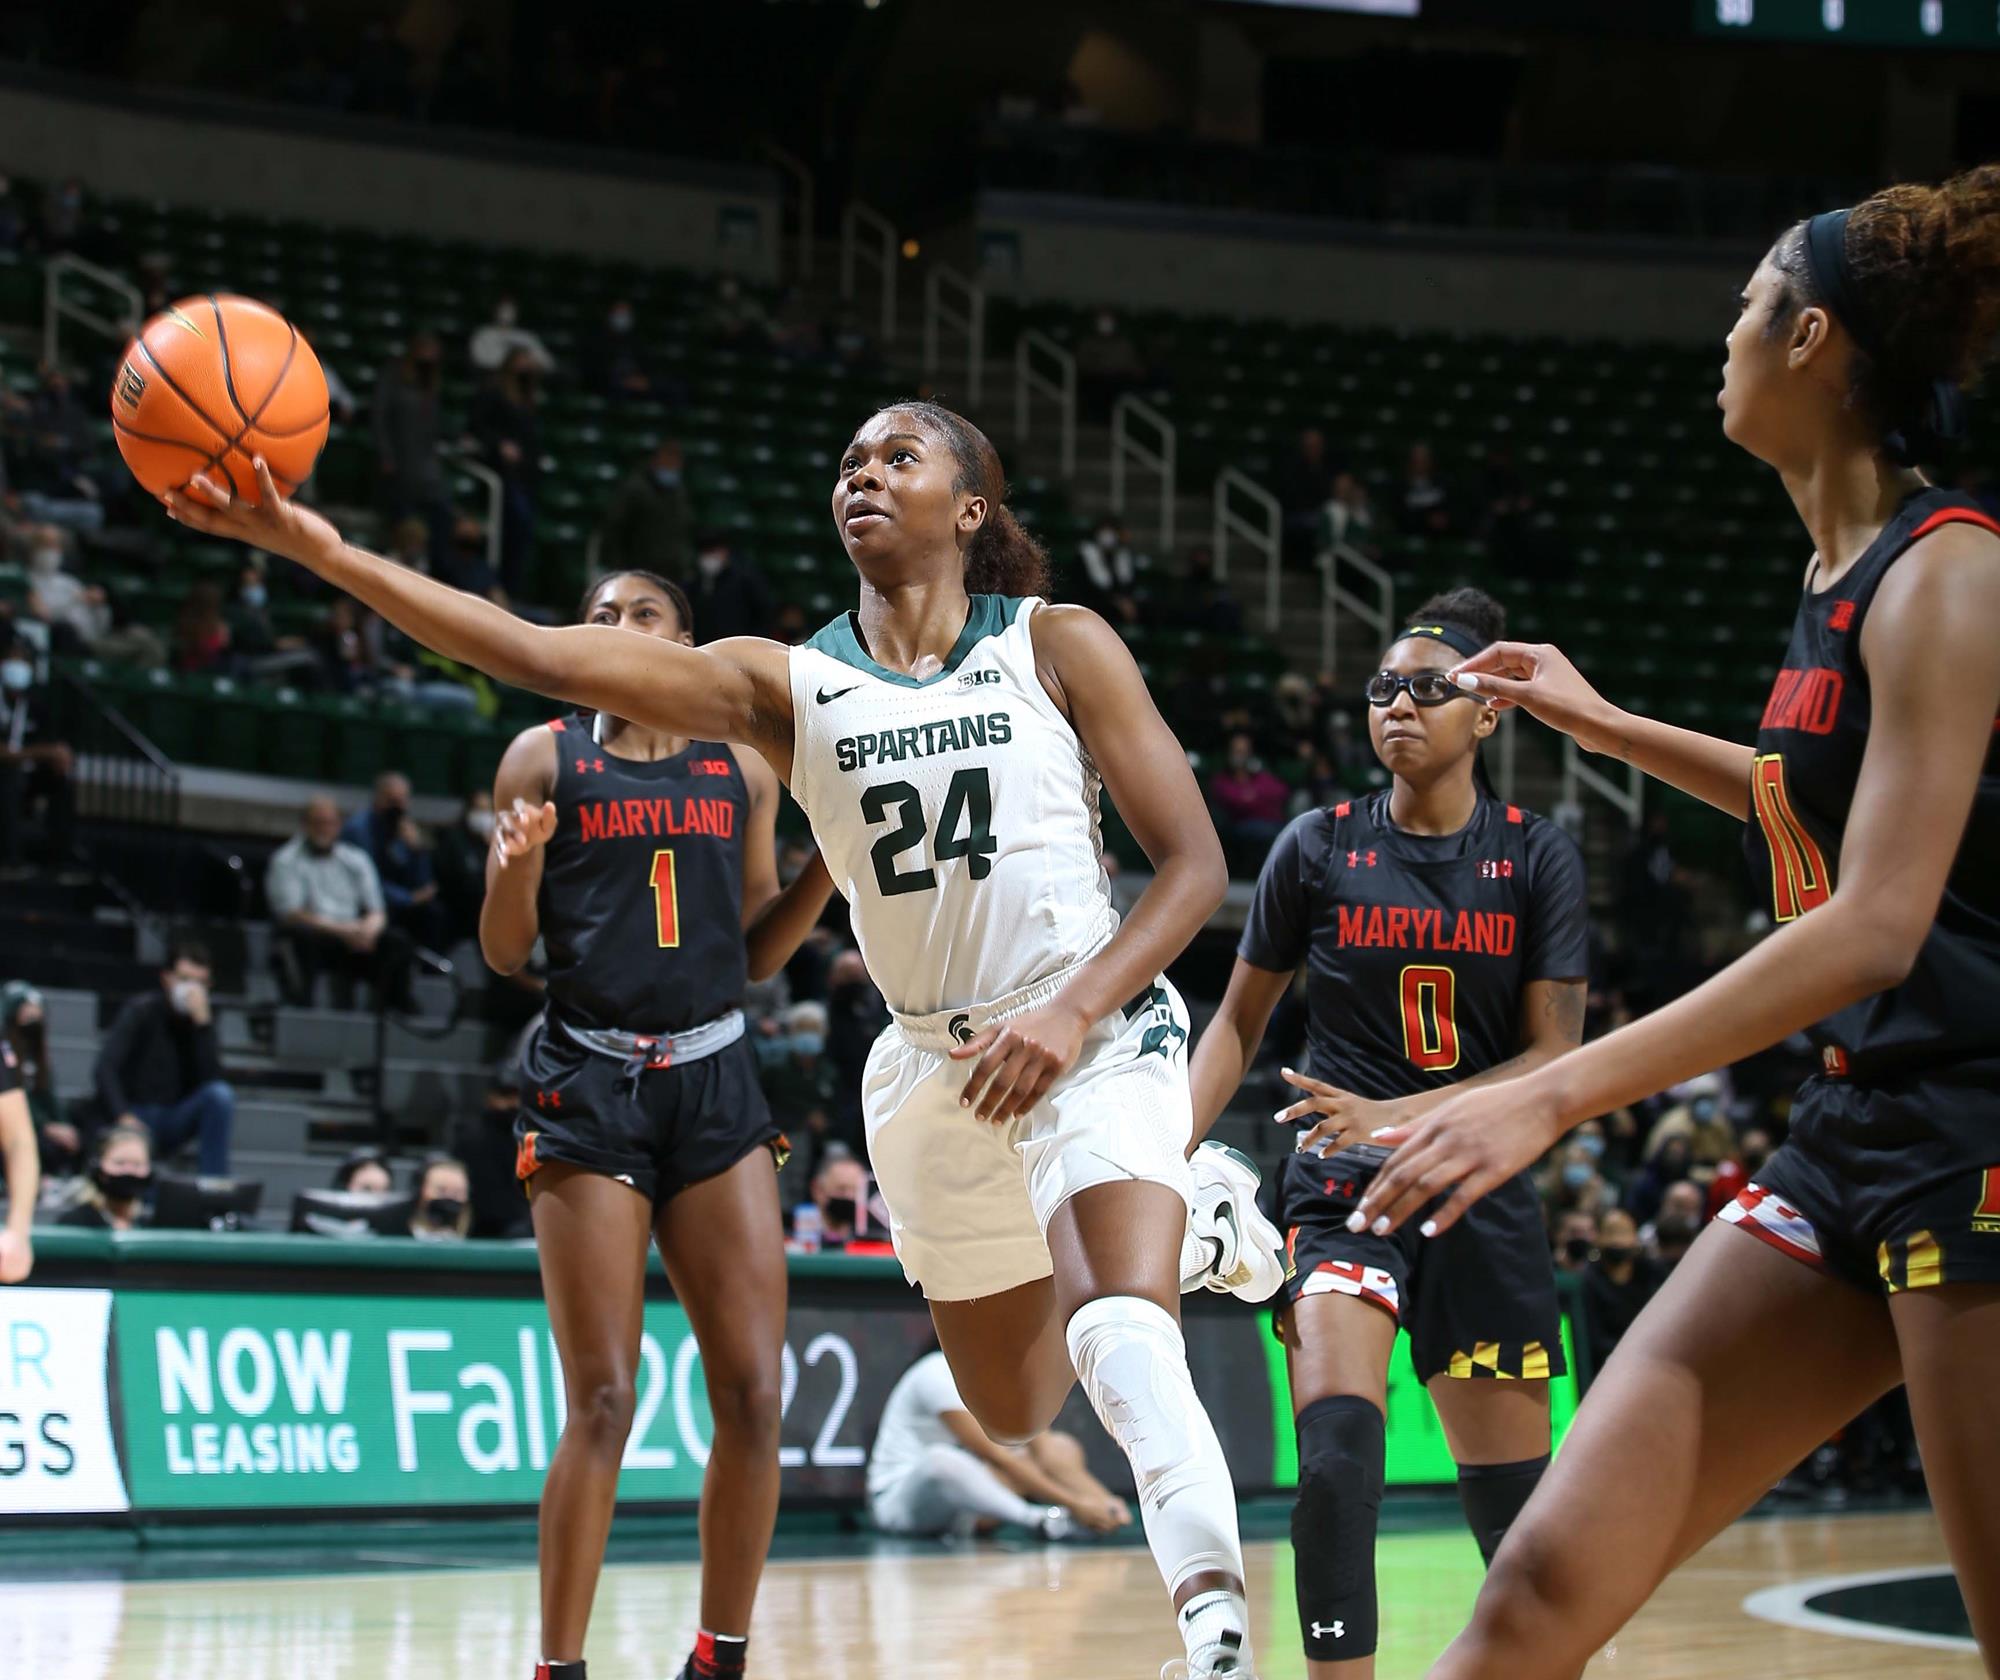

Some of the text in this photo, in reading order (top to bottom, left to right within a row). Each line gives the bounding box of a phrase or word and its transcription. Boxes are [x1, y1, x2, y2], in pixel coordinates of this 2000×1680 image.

[835, 712, 1013, 773] SPARTANS
[578, 797, 734, 844] MARYLAND
[859, 766, 998, 897] 24
[649, 848, 680, 948] 1
[1336, 904, 1517, 958] MARYLAND
[1400, 964, 1460, 1072] 0
[154, 1325, 352, 1418] NOW
[387, 1325, 569, 1474] Fall
[164, 1422, 361, 1475] LEASING
